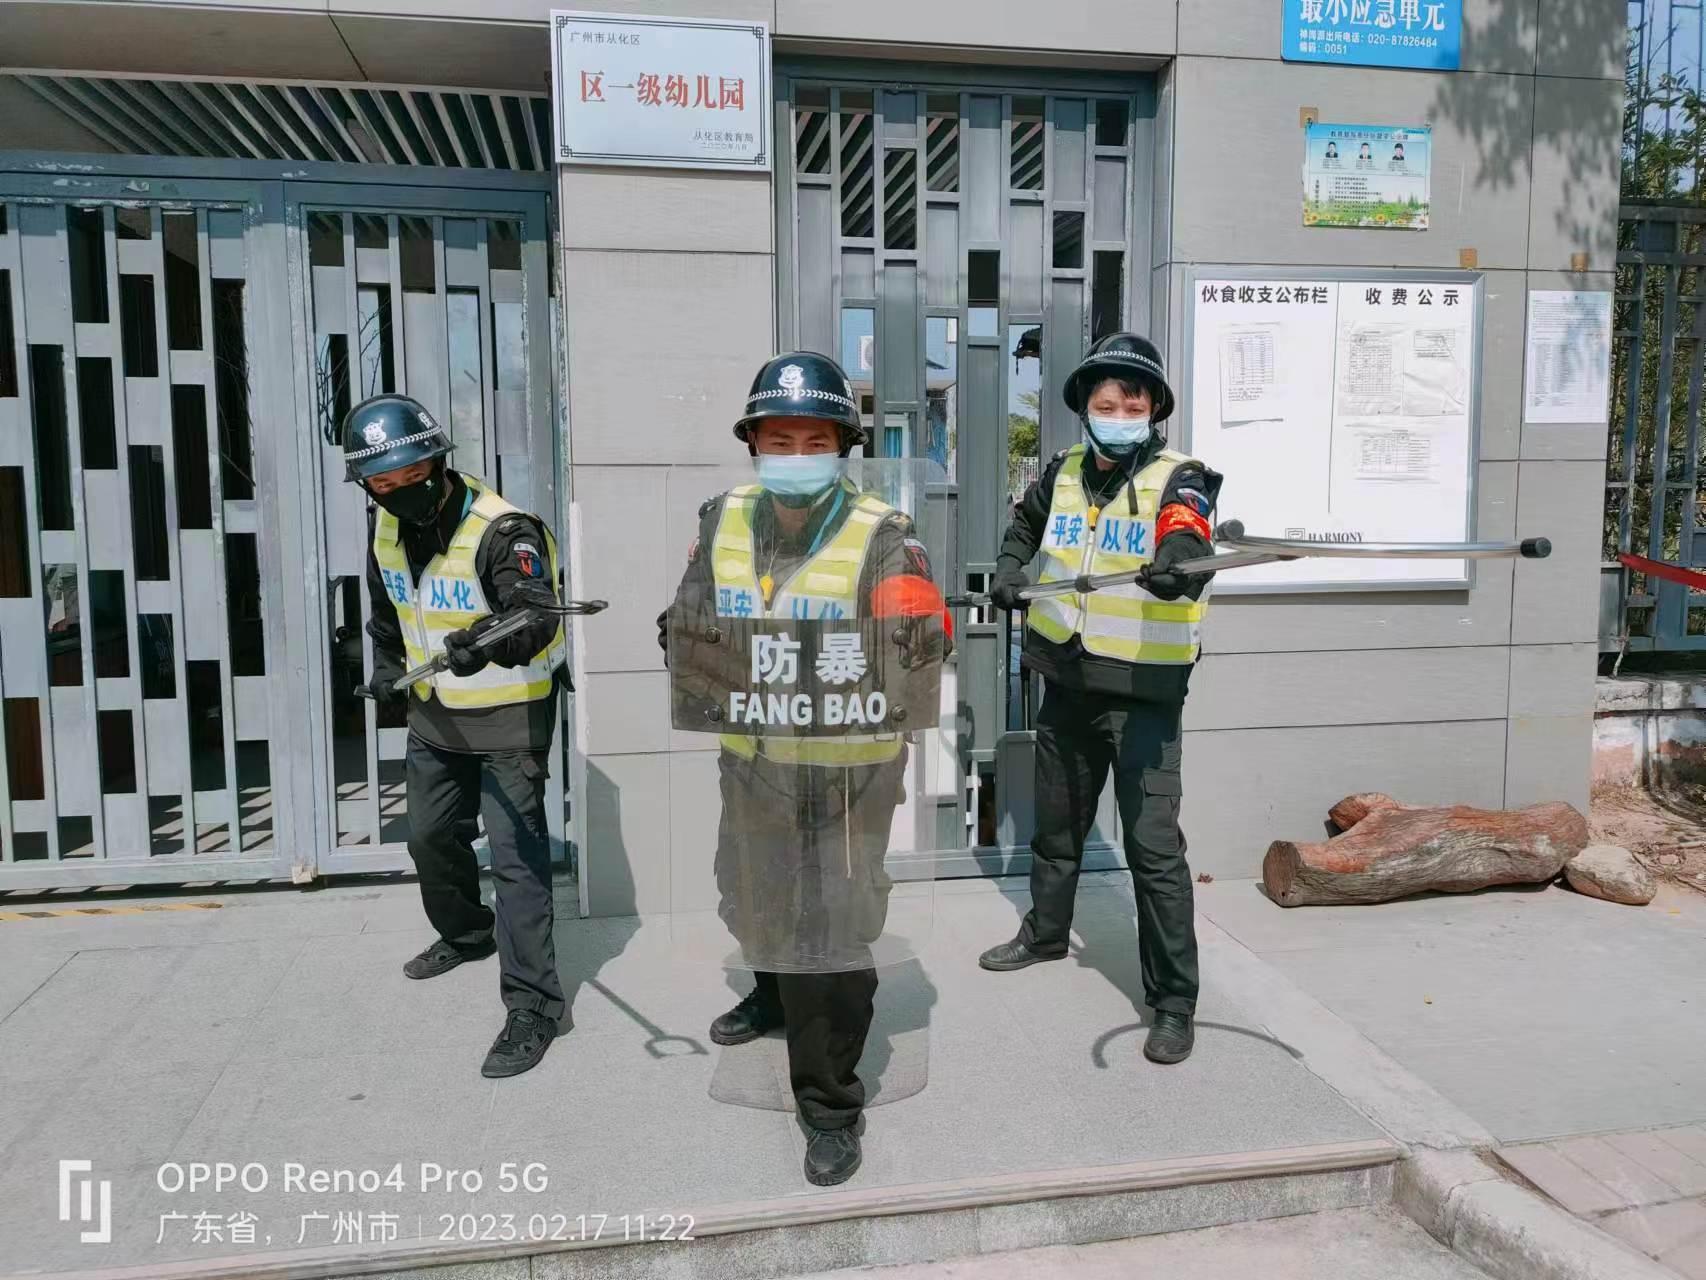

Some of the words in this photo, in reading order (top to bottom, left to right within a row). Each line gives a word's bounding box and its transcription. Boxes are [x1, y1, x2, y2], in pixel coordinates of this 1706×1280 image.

[1299, 0, 1445, 31] 最小应急单元
[570, 31, 641, 46] 广州市从化区
[580, 70, 744, 111] 区一级幼儿园
[694, 130, 754, 144] 从化区教育局
[1202, 286, 1328, 304] 伙食收支公布栏
[1051, 515, 1082, 546] 平安
[1101, 519, 1146, 555] 从化
[1308, 531, 1363, 543] HARMONY
[383, 569, 408, 603] 平安
[430, 578, 475, 611] 从化
[718, 588, 753, 618] 平安
[751, 631, 868, 686] 防暴
[730, 692, 812, 726] FANG
[823, 691, 887, 726] BAO
